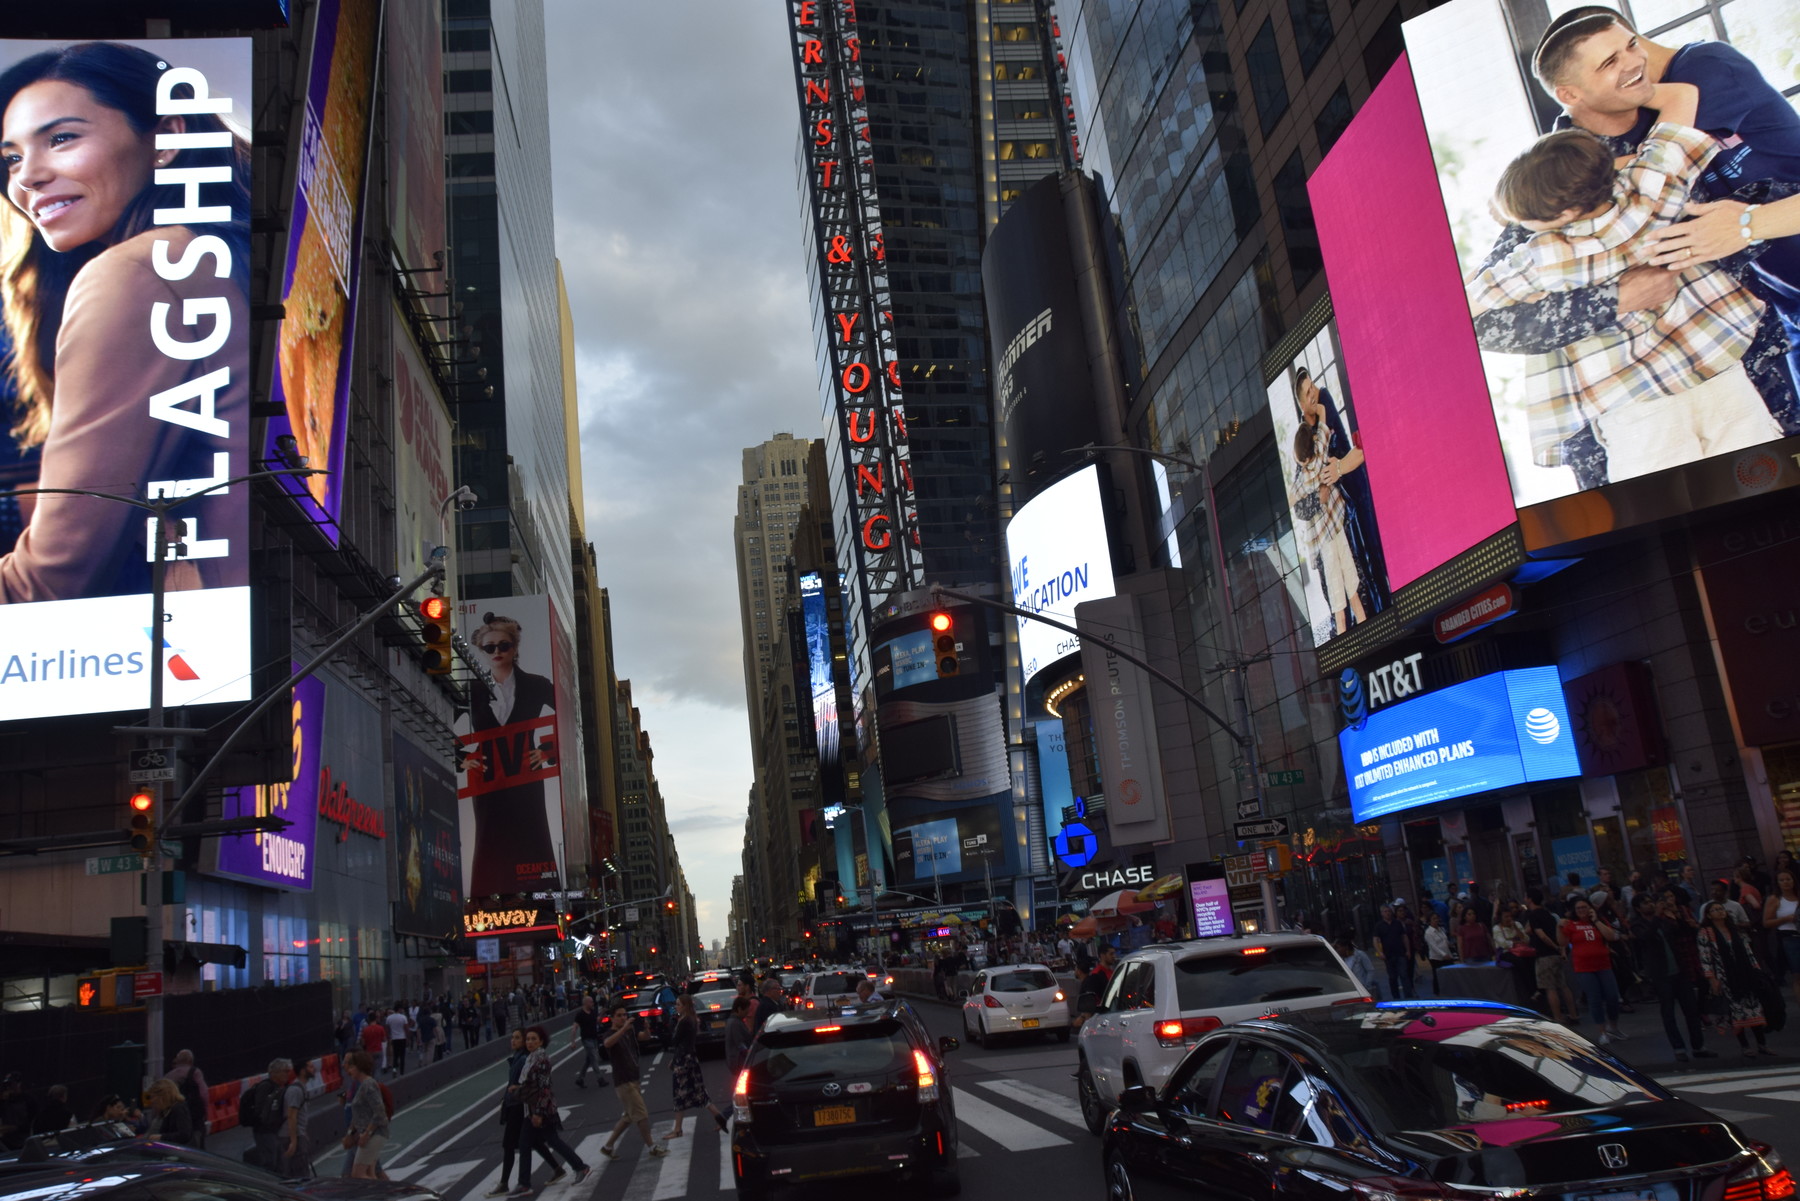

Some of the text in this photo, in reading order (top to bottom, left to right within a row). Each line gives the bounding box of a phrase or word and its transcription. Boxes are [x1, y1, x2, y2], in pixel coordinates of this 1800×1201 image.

[800, 1, 838, 188] ERNST
[827, 235, 853, 263] &
[147, 66, 233, 563] FLAGSHIP
[837, 312, 891, 550] YOUNG
[1440, 609, 1471, 634] BRANDED
[1056, 633, 1081, 656] CHAS
[0, 648, 144, 685] Airlines
[1367, 652, 1425, 709] AT&T
[1104, 632, 1132, 770] REUTES THOMSON
[1378, 736, 1414, 761] INCLUDED
[1413, 727, 1440, 748] WITH
[131, 768, 174, 780] BIKE LANE
[1363, 763, 1394, 787] UNLIMITED
[1393, 750, 1439, 776] ENHANCED
[1438, 740, 1475, 764] PLANS
[1270, 773, 1279, 785] W
[1282, 772, 1293, 784] 43
[1241, 823, 1280, 835] ONE WAY
[100, 859, 112, 872] W
[116, 857, 131, 871] 43
[262, 831, 306, 880] ENOUGH?
[1082, 866, 1154, 890] CHASE
[463, 908, 539, 929] ubway
[1583, 929, 1596, 941] 13
